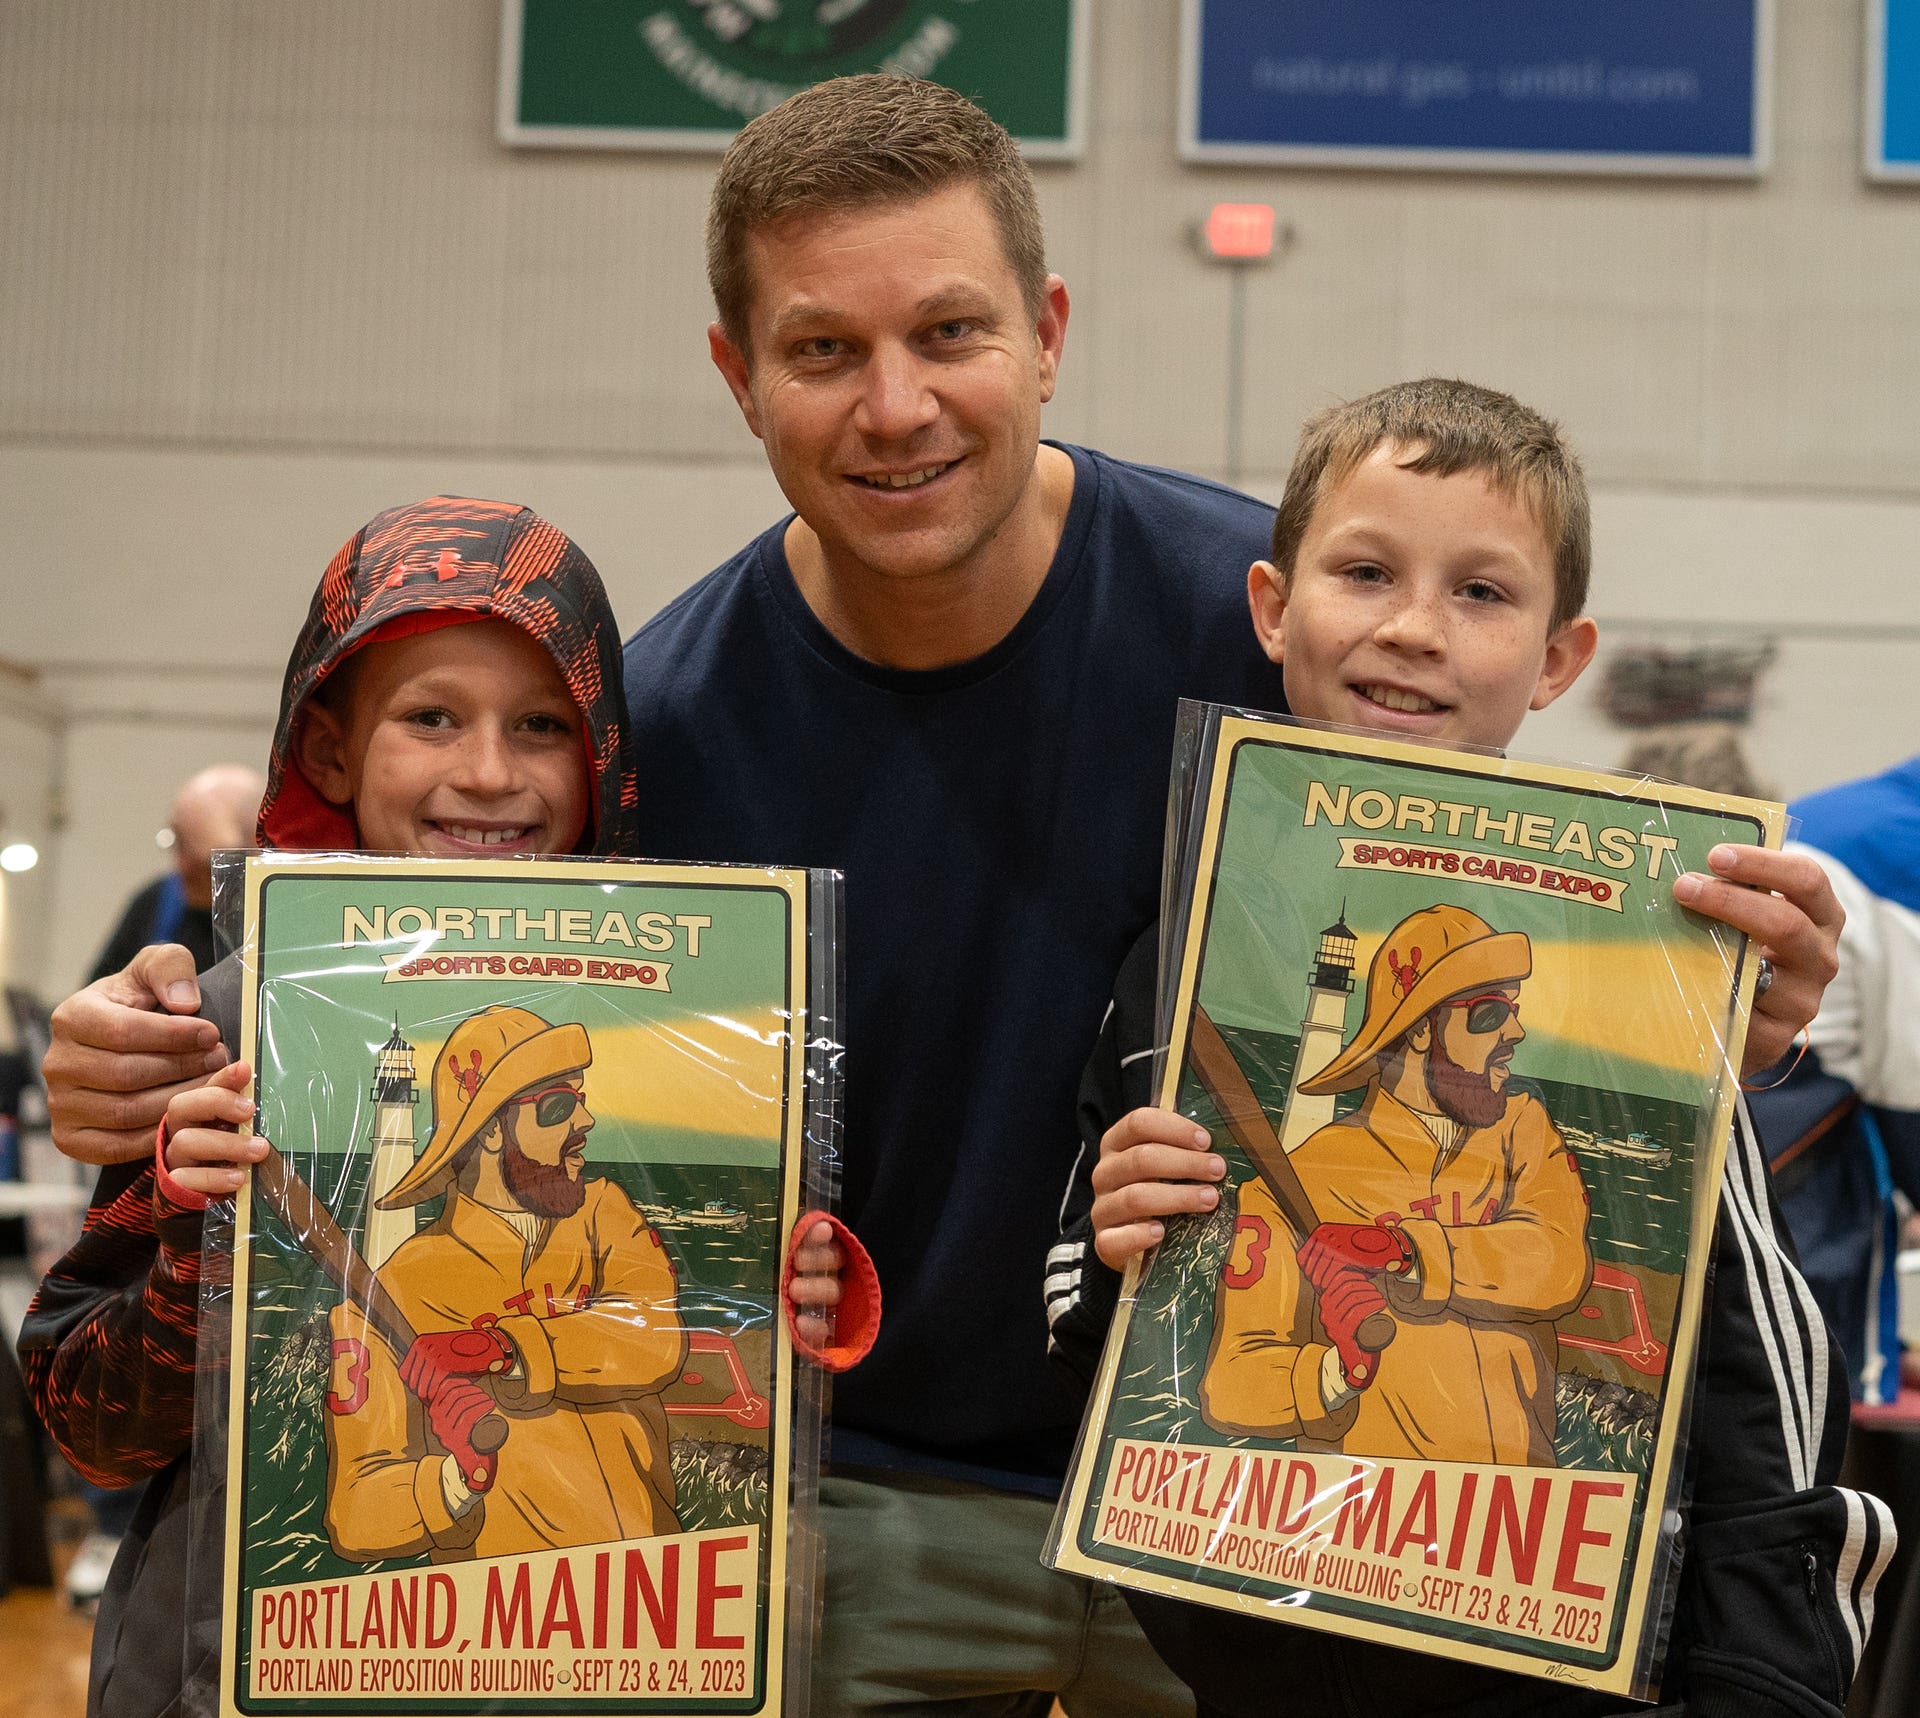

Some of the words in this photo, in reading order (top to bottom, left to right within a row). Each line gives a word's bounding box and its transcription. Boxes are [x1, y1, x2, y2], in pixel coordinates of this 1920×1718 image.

[1302, 781, 1679, 880] NORTHEAST
[1353, 844, 1460, 873] SPORTS
[1462, 856, 1537, 884] CARD
[1539, 870, 1612, 902] EXPO
[342, 905, 712, 957] NORTHEAST
[398, 956, 506, 977] SPORTS
[509, 957, 583, 977] CARD
[587, 960, 657, 985] EXPO
[1221, 1215, 1272, 1290] 3
[325, 1338, 370, 1416] 3
[1113, 1445, 1322, 1543] PORTLAND,
[1332, 1464, 1625, 1601] MAINE
[260, 1572, 471, 1653] PORTLAND,
[481, 1536, 748, 1649] MAINE
[1103, 1505, 1199, 1556] PORTLAND
[1205, 1529, 1307, 1582] EXPOSITION
[1313, 1553, 1403, 1601] BUILDING
[1417, 1575, 1464, 1615] SEPT
[1465, 1585, 1492, 1621] 23
[1496, 1594, 1511, 1626] &
[1515, 1596, 1544, 1636] 24,
[1551, 1603, 1602, 1645] 2023
[258, 1658, 353, 1692] PORTLAND
[360, 1658, 463, 1692] EXPOSITION
[470, 1658, 554, 1692] BUILDING
[573, 1658, 613, 1692] SEPT
[619, 1659, 640, 1692] 23
[648, 1659, 660, 1692] &
[667, 1659, 693, 1694] 24,
[700, 1659, 745, 1692] 2023
